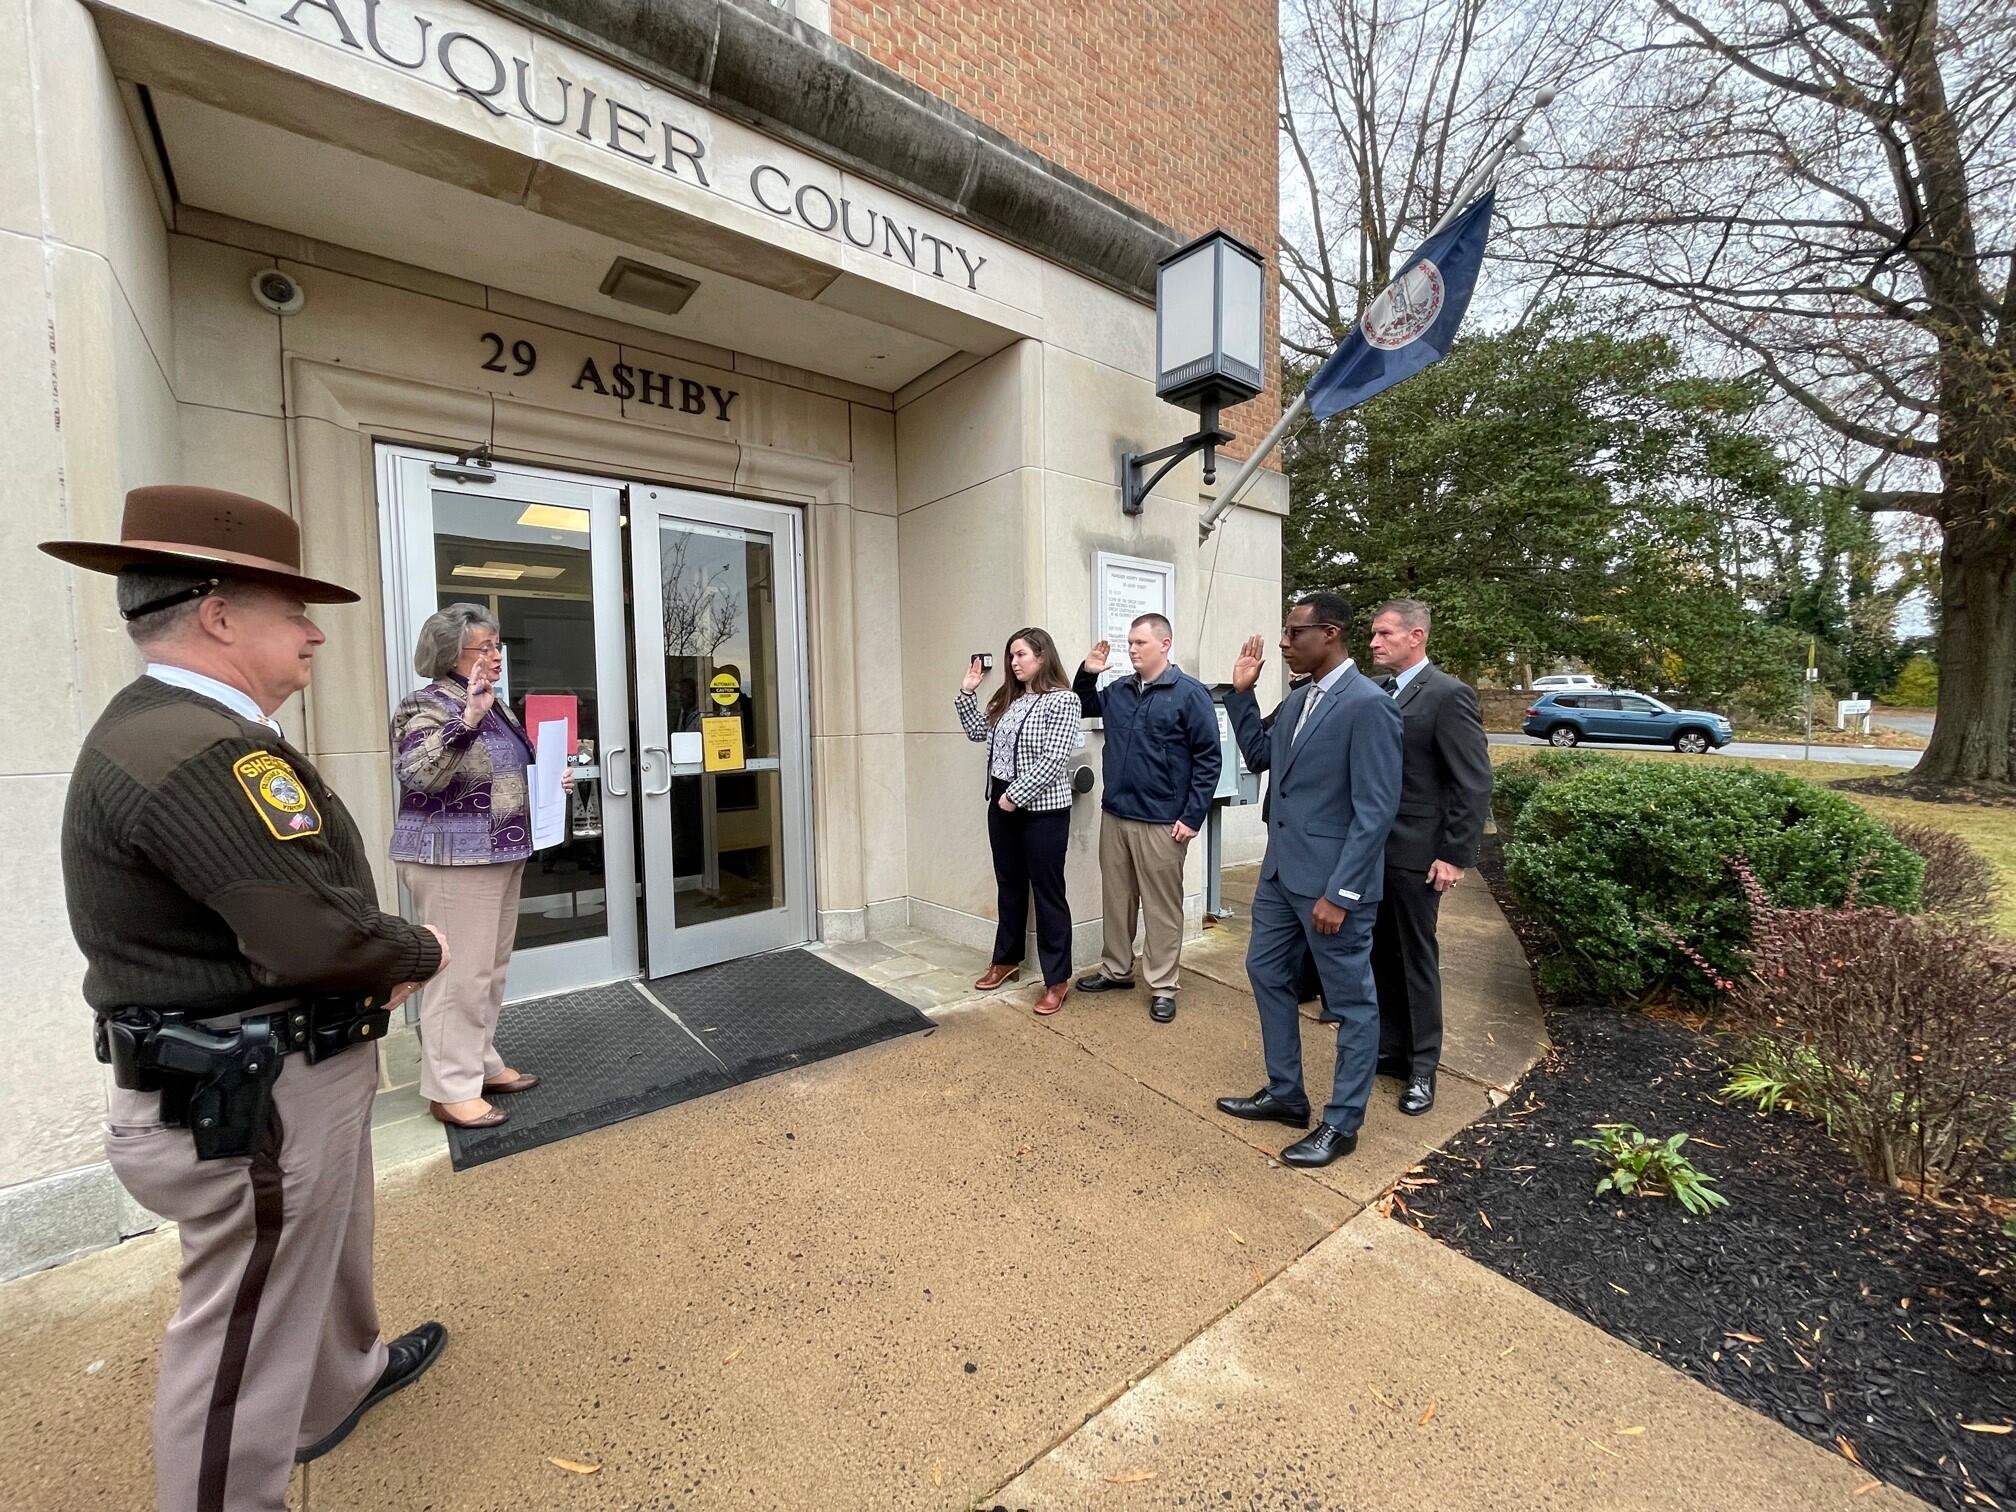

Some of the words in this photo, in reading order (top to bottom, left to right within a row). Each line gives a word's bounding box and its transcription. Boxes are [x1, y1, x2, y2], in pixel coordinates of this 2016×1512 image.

[232, 0, 711, 187] AUQUIER
[749, 163, 988, 290] COUNTY
[480, 332, 537, 377] 29
[571, 356, 740, 422] ASHBY
